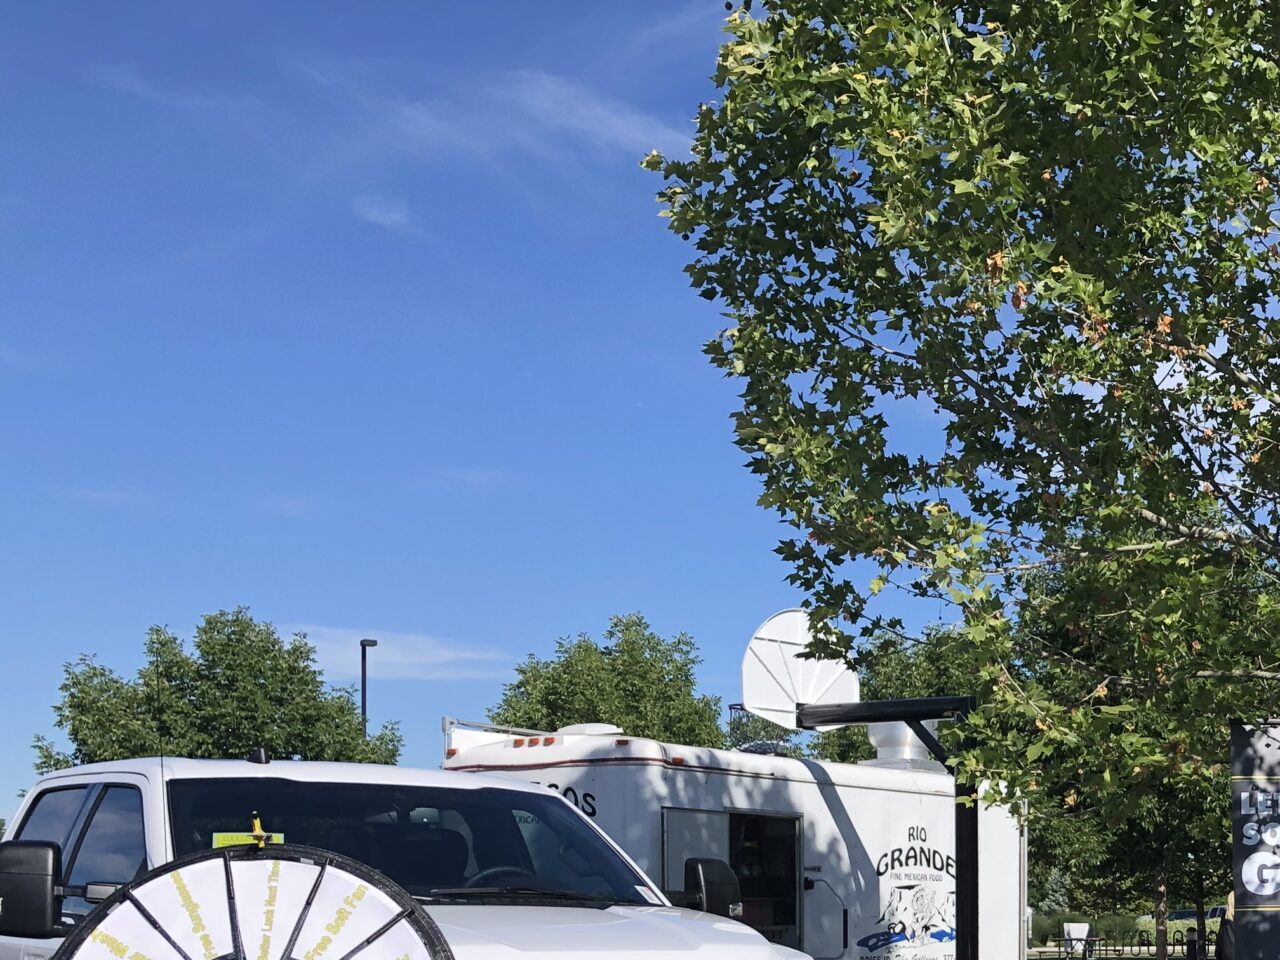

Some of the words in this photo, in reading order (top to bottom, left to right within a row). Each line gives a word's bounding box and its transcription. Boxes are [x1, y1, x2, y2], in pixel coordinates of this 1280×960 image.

[908, 825, 927, 842] RIO
[876, 846, 956, 881] GRANDE
[261, 907, 275, 932] Luck
[325, 907, 352, 935] Soft
[343, 884, 369, 909] Fan
